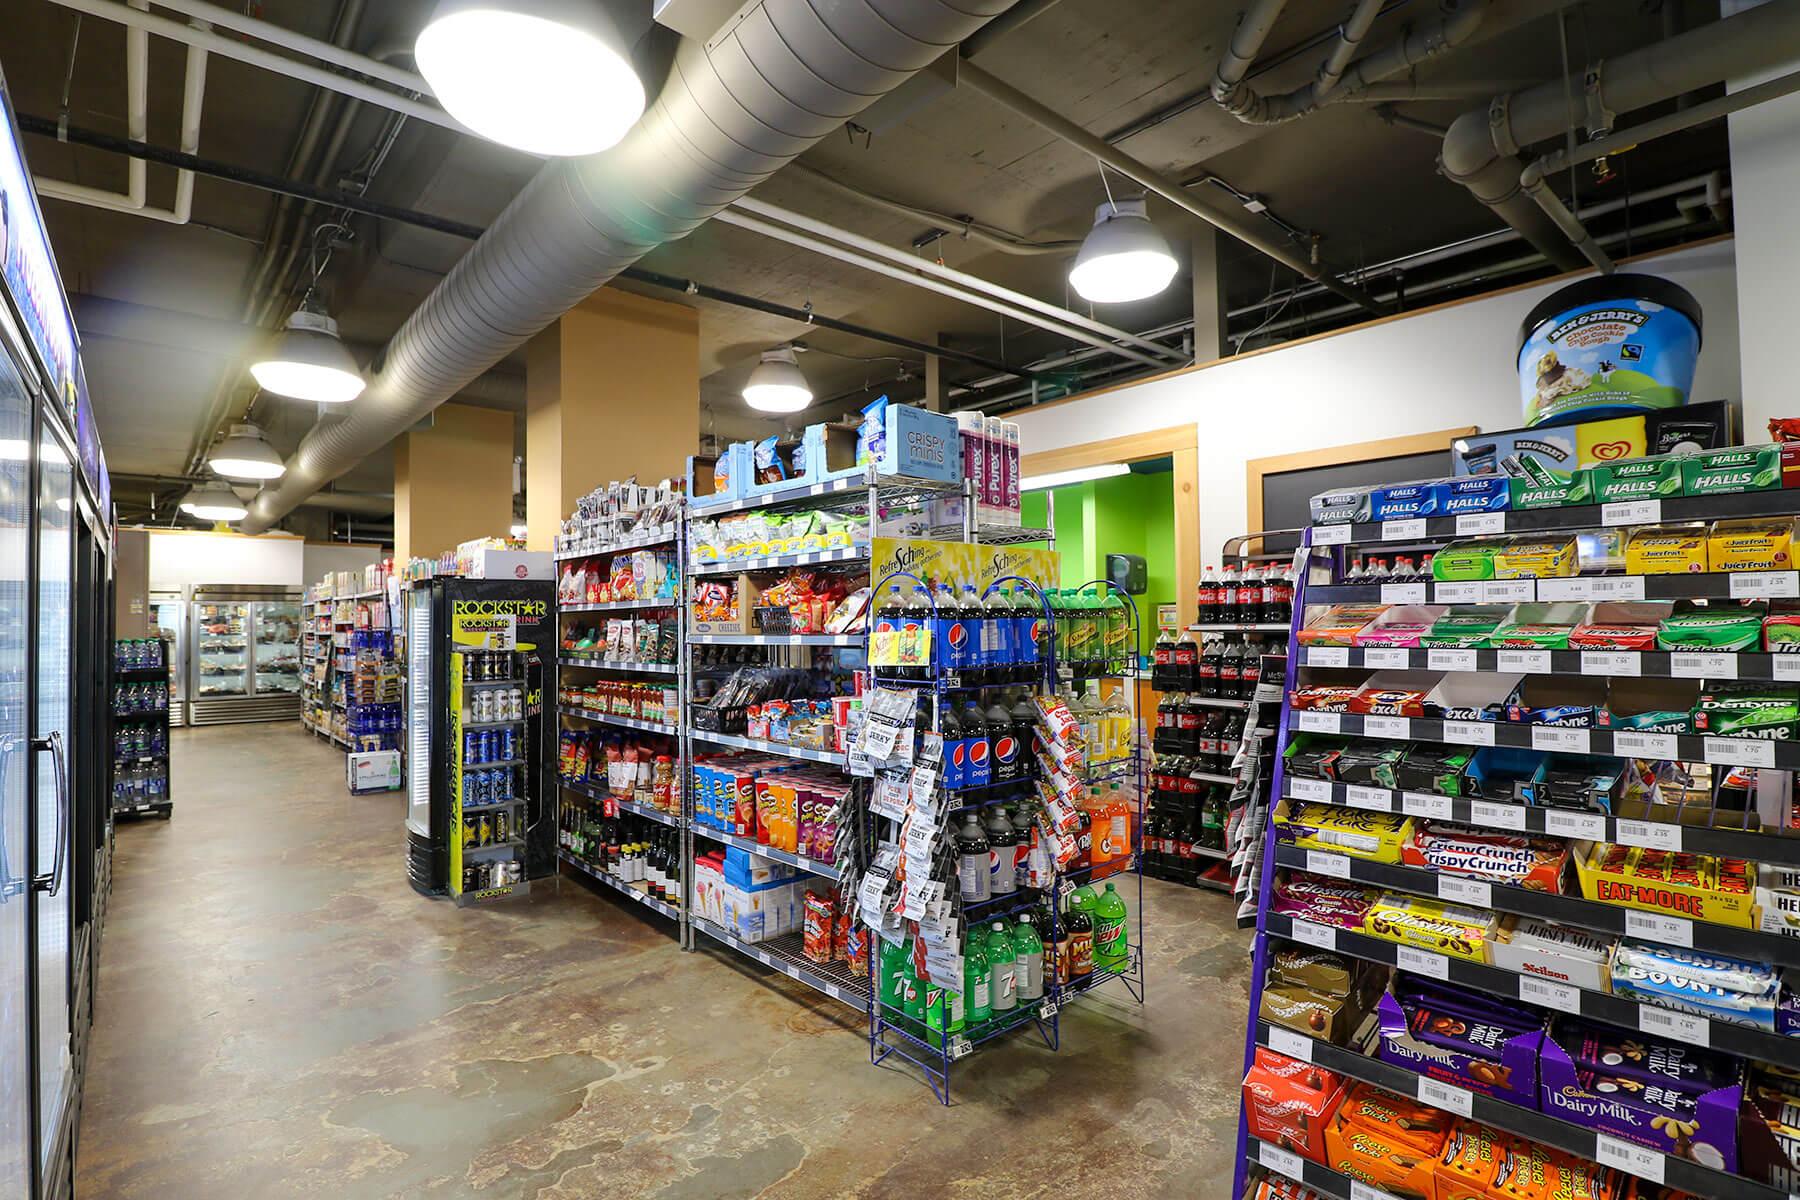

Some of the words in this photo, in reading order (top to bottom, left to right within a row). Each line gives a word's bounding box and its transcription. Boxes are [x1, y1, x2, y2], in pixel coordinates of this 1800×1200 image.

[1567, 324, 1626, 341] Chocolate
[1580, 337, 1610, 346] Dough
[1712, 454, 1750, 464] HALLS
[1619, 464, 1654, 474] HALLS
[1459, 480, 1488, 490] HALLS
[1604, 480, 1656, 496] HALLS
[1694, 472, 1752, 488] HALLS
[1390, 488, 1417, 497] HALLS
[1520, 488, 1567, 502] HALLS
[1380, 502, 1418, 514] HALLS
[1447, 496, 1488, 510] HALLS
[1320, 509, 1354, 520] HALLS
[1722, 561, 1746, 570] Juicy
[1748, 560, 1772, 568] Fruit
[454, 599, 546, 616] ROCKSTAR
[461, 618, 511, 628] ROCKSTAR
[1370, 704, 1402, 715] excel
[1702, 700, 1792, 710] Dentyne
[1446, 708, 1482, 720] excel
[870, 731, 890, 744] JERKY
[1428, 840, 1535, 862] CrispyCrunch
[1422, 851, 1528, 873] CrispyCrunch
[1288, 882, 1364, 898] Glosette
[1597, 880, 1704, 918] EAT-MORE
[1378, 910, 1465, 936] Glosette
[1524, 924, 1567, 942] JERSEY
[1570, 935, 1602, 952] MILK
[1523, 962, 1568, 980] Neilson
[1468, 1024, 1482, 1044] Milk
[1482, 1025, 1503, 1050] Dairy
[1388, 1040, 1424, 1062] Dairy
[1648, 1045, 1667, 1074] Milk
[1663, 1048, 1685, 1080] Dairy
[1359, 1098, 1398, 1116] Reese
[1554, 1092, 1598, 1116] Dairy
[1600, 1104, 1642, 1126] Milk
[1358, 1107, 1389, 1124] Sticks
[1351, 1134, 1391, 1154] Reese
[1339, 1160, 1376, 1181] Reese
